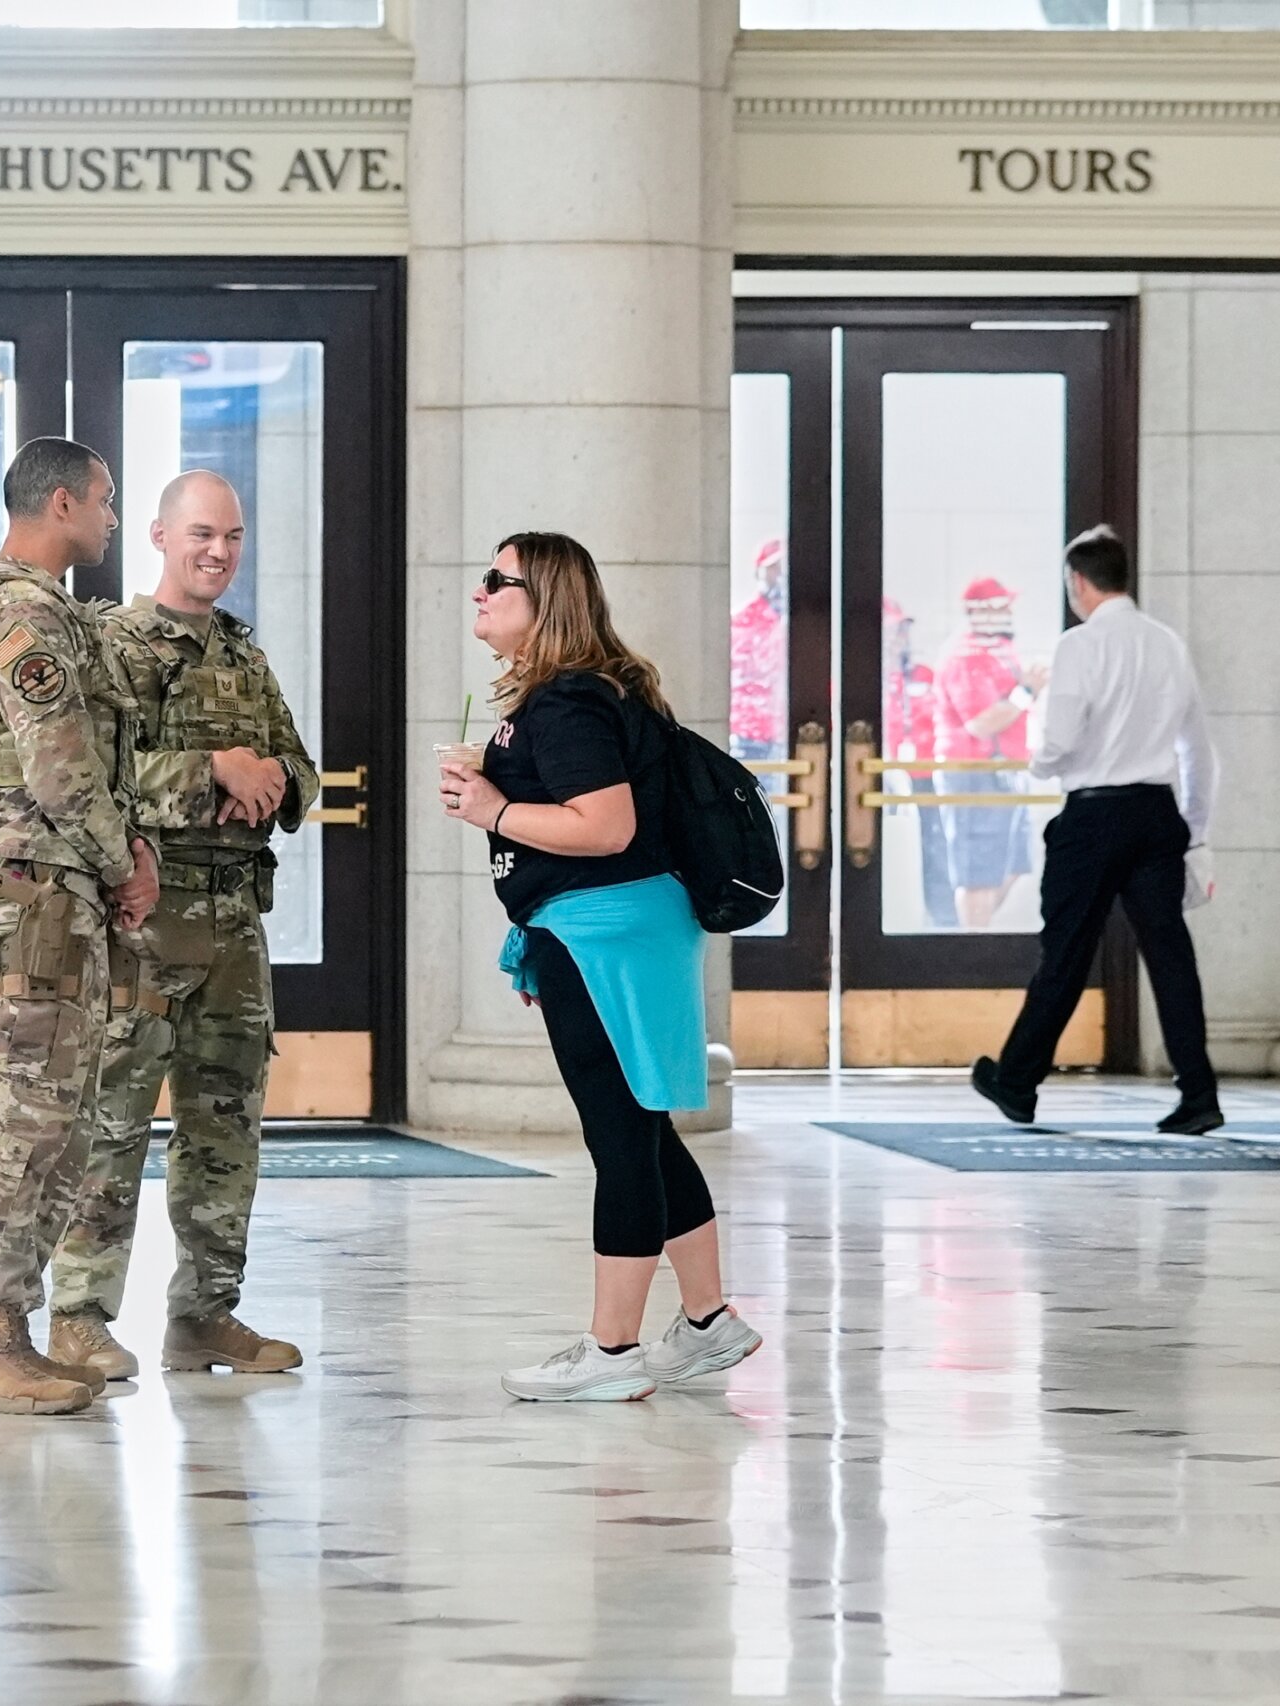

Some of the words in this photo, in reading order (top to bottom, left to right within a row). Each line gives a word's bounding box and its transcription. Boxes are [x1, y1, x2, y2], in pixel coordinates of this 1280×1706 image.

[279, 147, 403, 192] AVE.
[959, 148, 1153, 194] TOURS
[491, 852, 515, 880] GE
